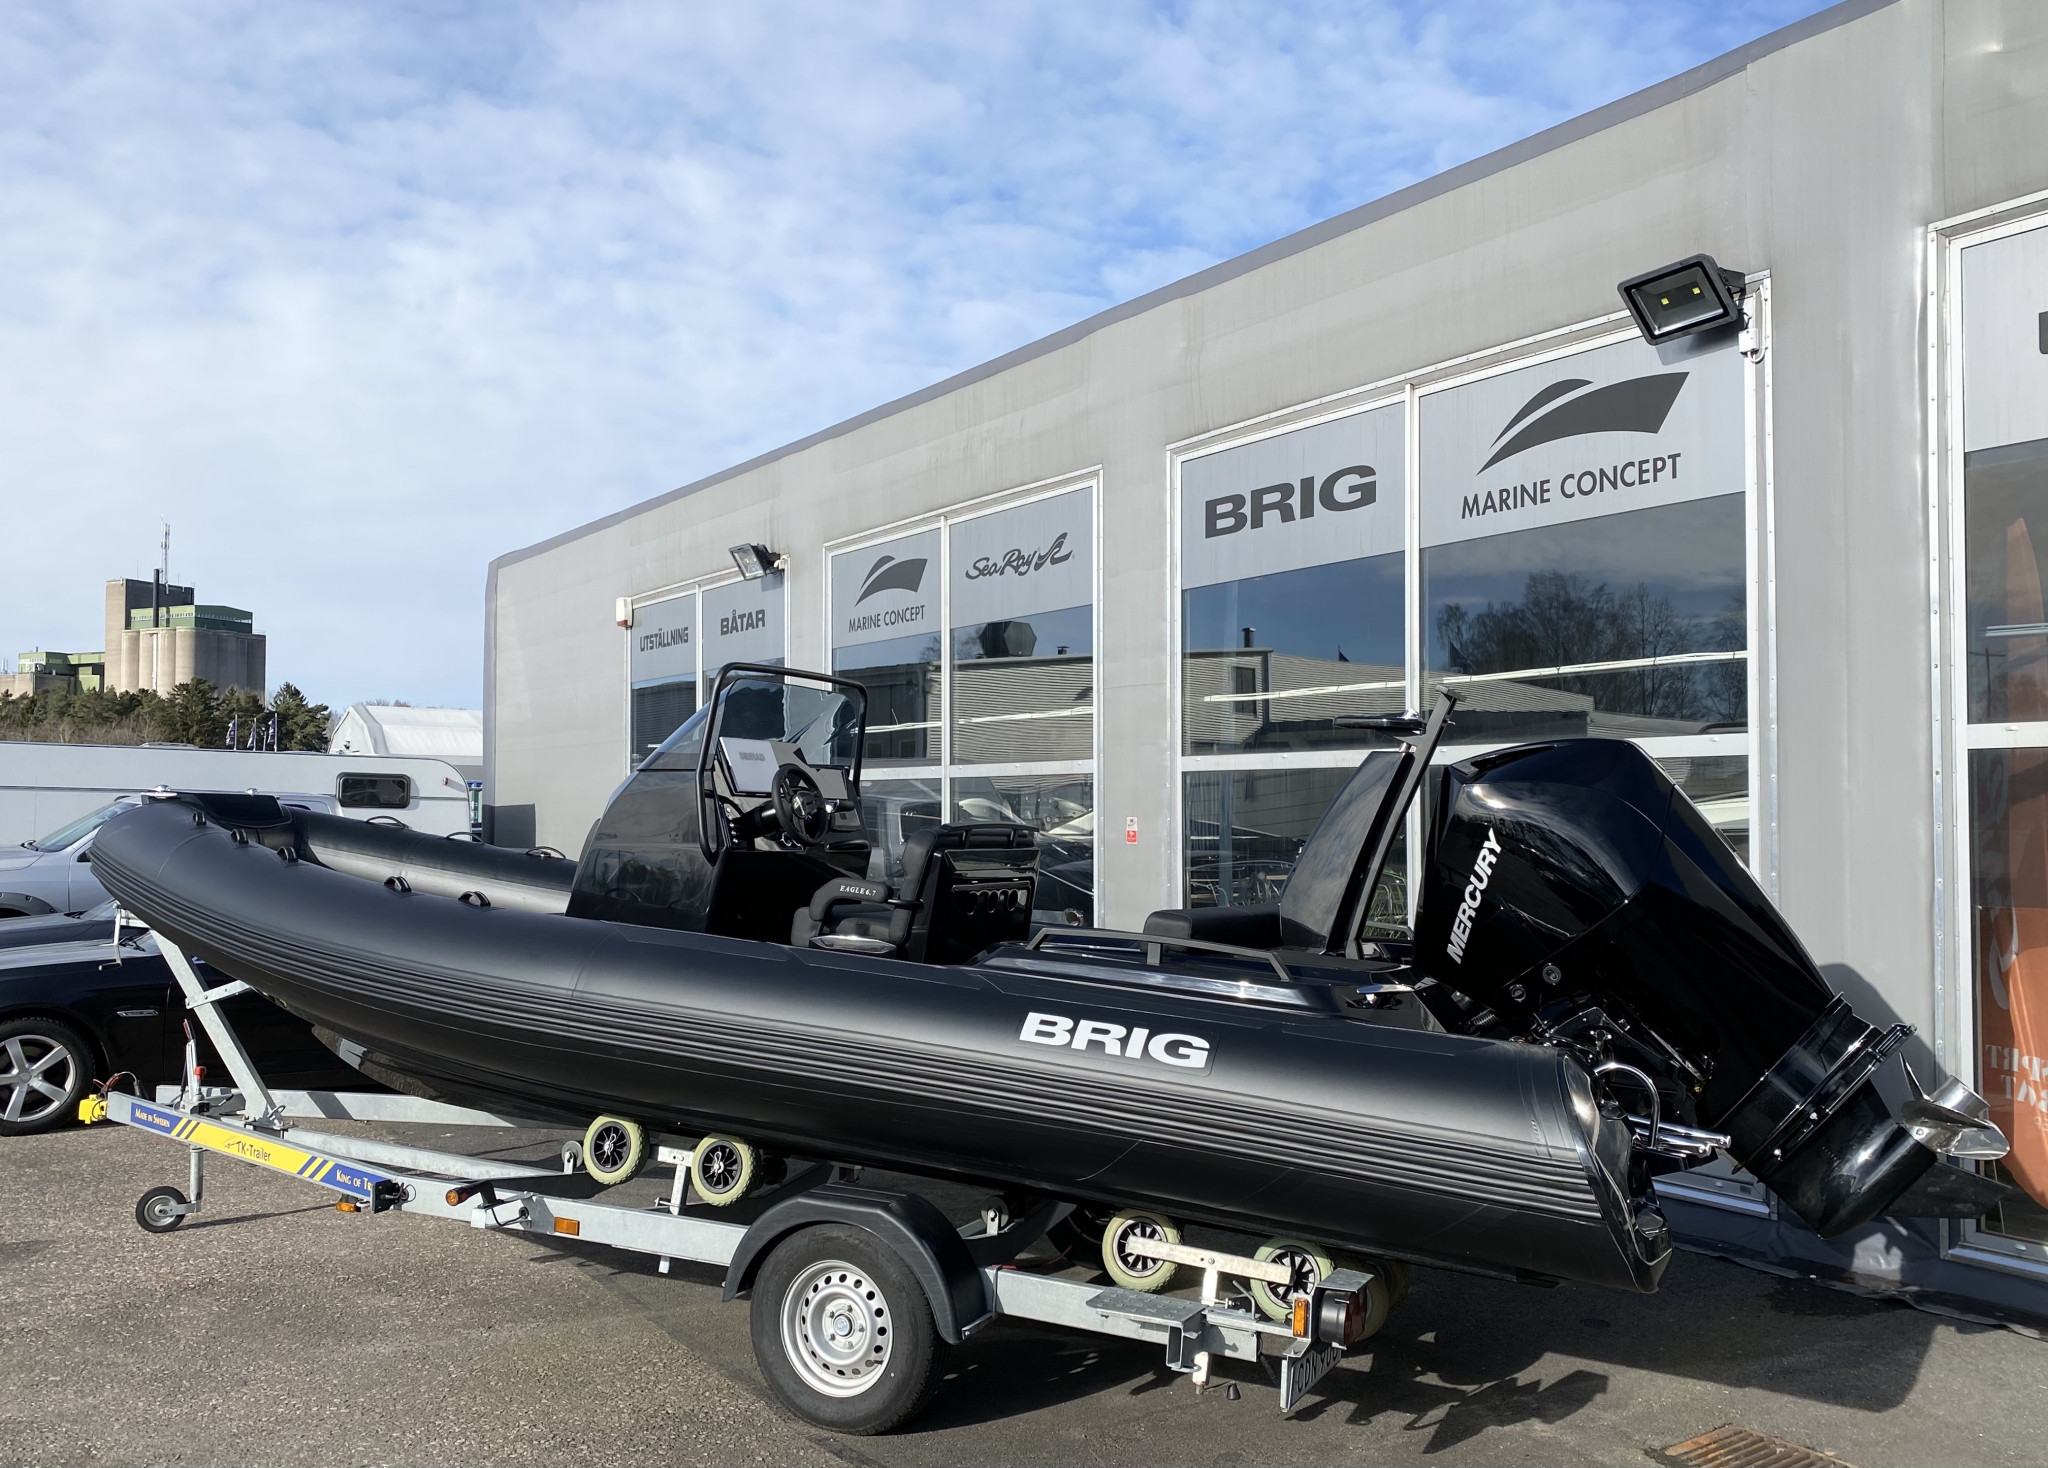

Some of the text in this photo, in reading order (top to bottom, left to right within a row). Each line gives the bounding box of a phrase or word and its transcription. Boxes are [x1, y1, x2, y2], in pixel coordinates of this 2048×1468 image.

[1205, 464, 1377, 539] BRIG
[1461, 452, 1681, 520] MARINE CONCEPT
[965, 548, 1037, 580] Sea Ray
[639, 626, 689, 652] UTSTÄLLNING
[720, 609, 766, 636] BÅTAR
[848, 604, 925, 634] MARINE CONCEPT
[1446, 827, 1502, 965] MERCURY
[1018, 1011, 1211, 1069] BRIG
